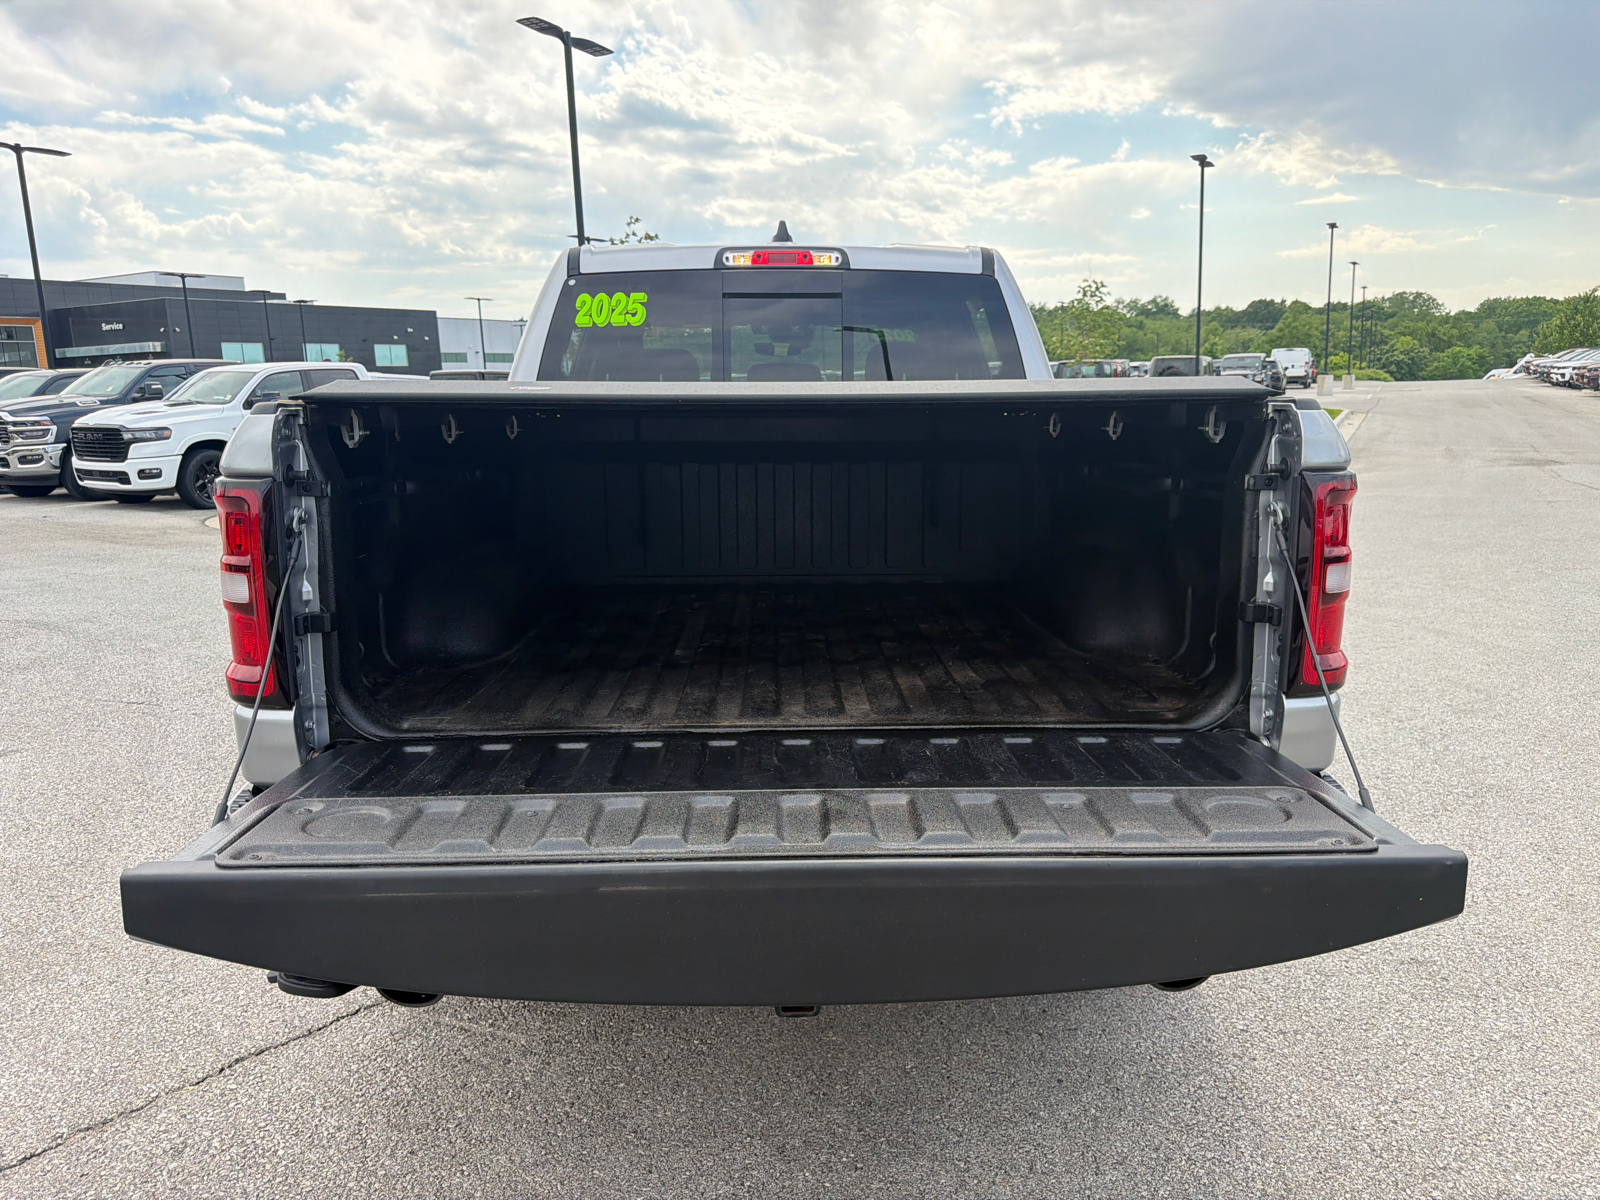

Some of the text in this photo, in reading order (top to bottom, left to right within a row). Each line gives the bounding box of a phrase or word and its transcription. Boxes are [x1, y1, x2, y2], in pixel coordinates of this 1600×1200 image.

[575, 291, 648, 328] 2025
[101, 321, 124, 331] Service
[77, 433, 104, 441] RAM
